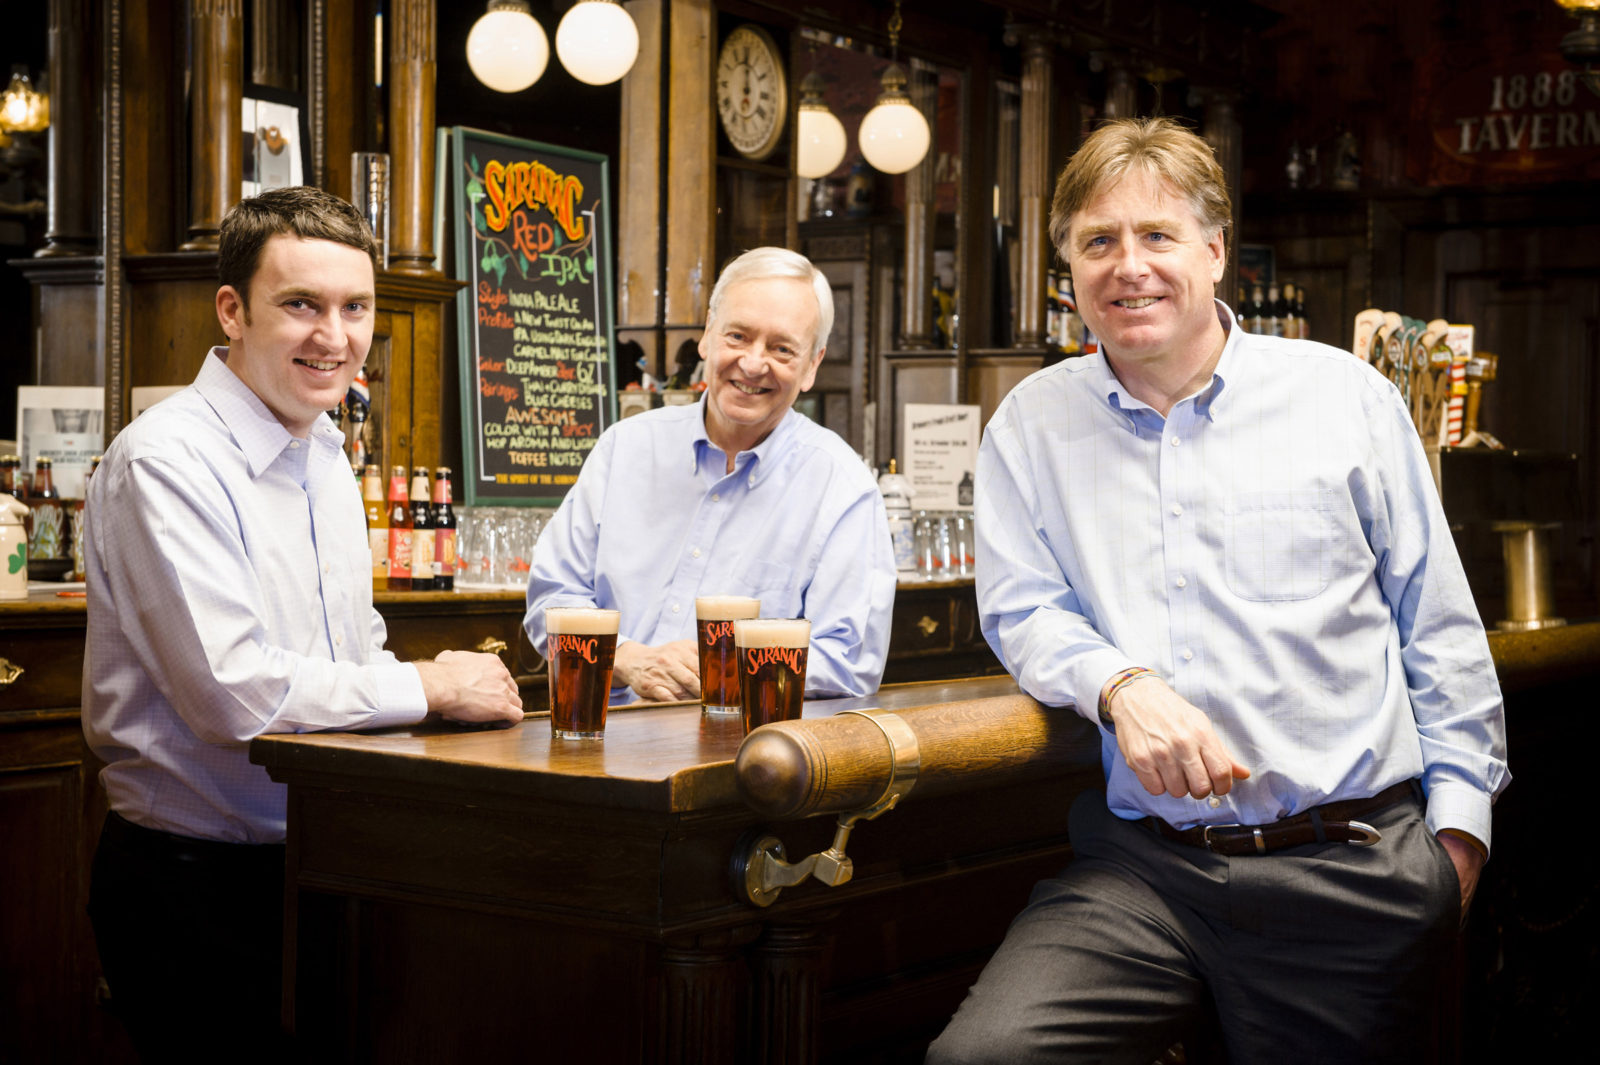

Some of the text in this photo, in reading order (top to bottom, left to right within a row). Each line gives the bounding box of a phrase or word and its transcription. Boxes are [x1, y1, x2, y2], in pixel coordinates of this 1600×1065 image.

[1489, 69, 1577, 111] 1888
[1455, 110, 1600, 154] TAVERN
[484, 160, 584, 241] SARANAC
[513, 210, 554, 261] RED
[540, 253, 589, 286] IPA
[484, 422, 520, 437] COLOR
[521, 424, 549, 437] WITH
[551, 425, 560, 436] A
[505, 405, 578, 426] AWESOME
[486, 437, 507, 449] HOP
[509, 435, 549, 449] AROMA
[551, 437, 571, 450] AND
[508, 451, 583, 467] TOFFEE NOTES
[706, 622, 735, 646] SARA
[548, 635, 598, 664] SARANAC
[747, 645, 803, 675] SARANAC
